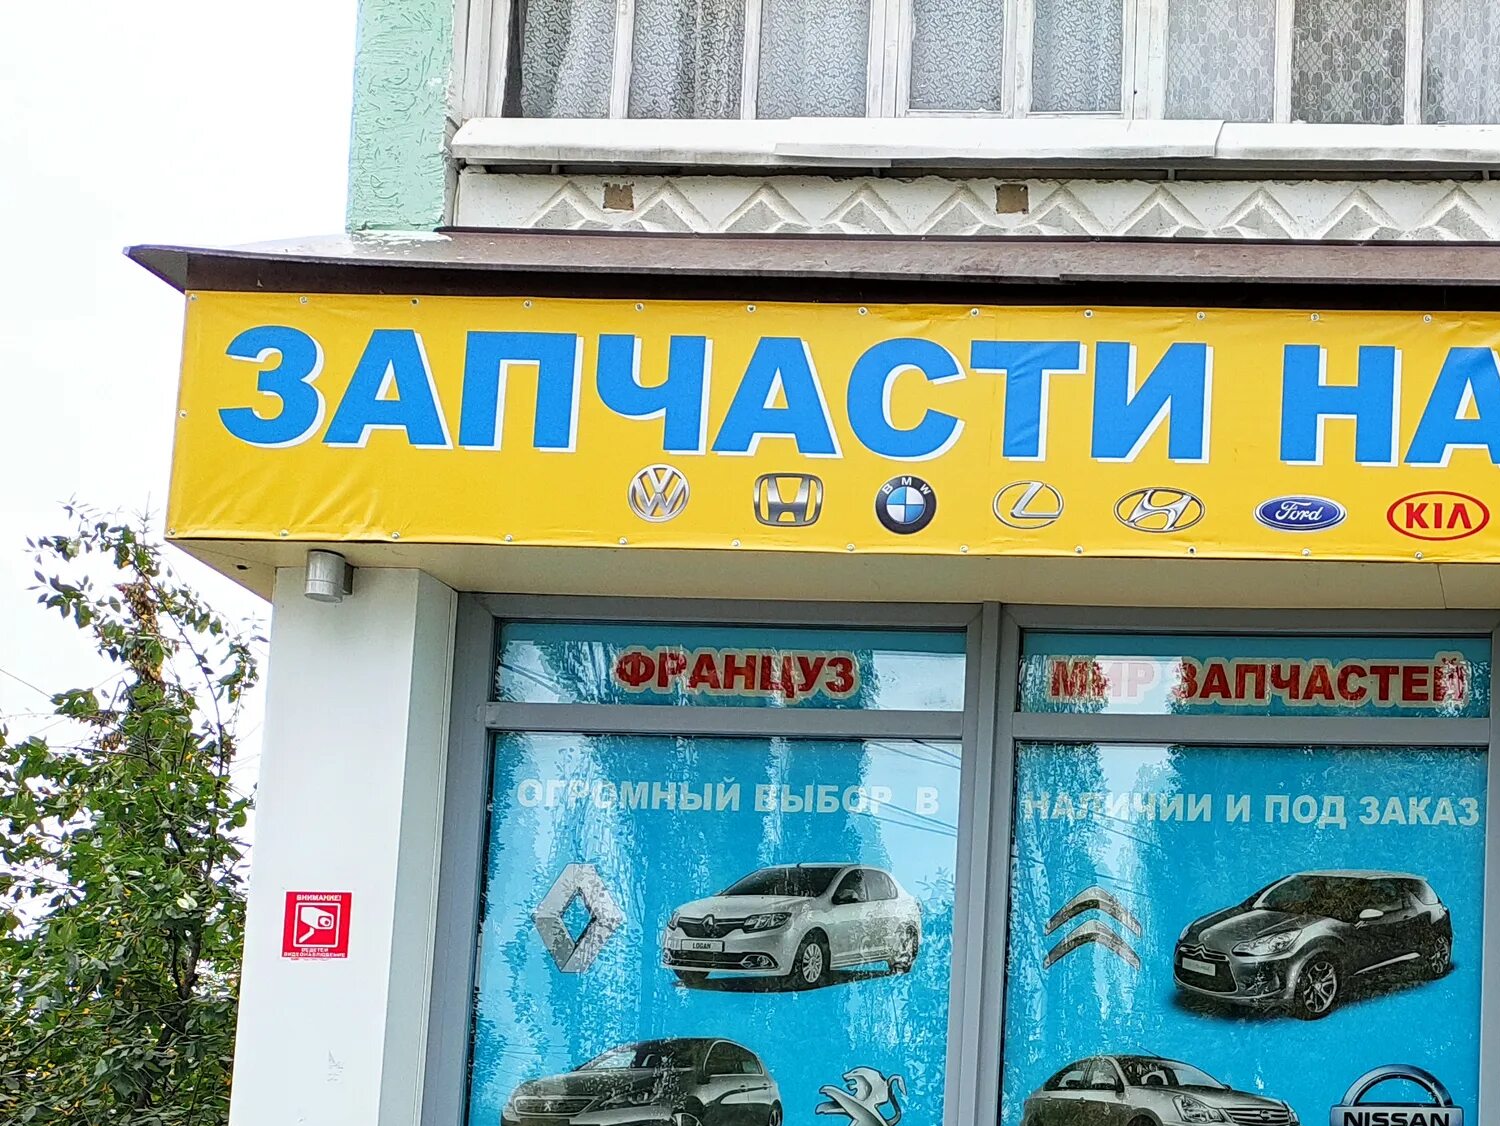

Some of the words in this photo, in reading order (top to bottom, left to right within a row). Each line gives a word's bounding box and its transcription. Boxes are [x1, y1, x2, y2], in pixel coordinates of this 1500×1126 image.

[219, 325, 1214, 464] ЗАПЧАСТИ
[882, 476, 931, 495] BMW
[1275, 500, 1324, 524] Ford
[1406, 502, 1468, 529] KIA
[615, 650, 856, 699] ФРАНЦУЗ
[1051, 660, 1155, 698] МИР
[1180, 654, 1467, 702] ЗАПЧАСТЕЙ
[517, 777, 741, 812] ОГРОМНЫЙ
[754, 783, 892, 815] ВЫБОР
[915, 786, 940, 815] В
[1021, 791, 1213, 823] НАЛИЧИИ
[1226, 794, 1251, 822] И
[1265, 795, 1348, 830] ПОД
[1358, 795, 1480, 826] ЗАКАЗ
